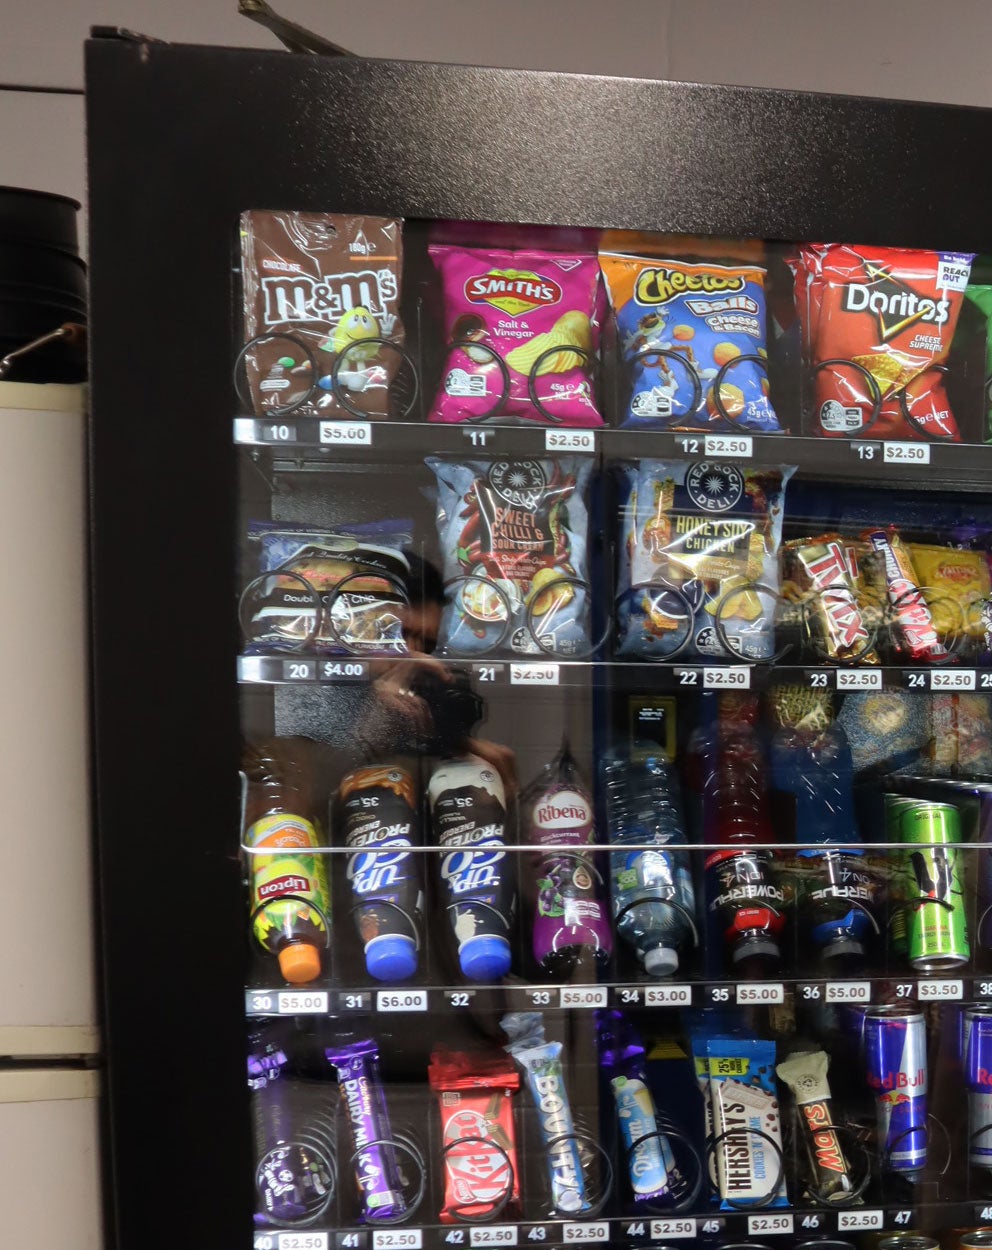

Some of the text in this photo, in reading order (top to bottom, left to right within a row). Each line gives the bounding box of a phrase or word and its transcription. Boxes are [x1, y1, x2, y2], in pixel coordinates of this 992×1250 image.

[635, 267, 745, 306] Cheetos
[687, 296, 759, 316] Balls
[846, 283, 951, 322] Doritos
[498, 320, 529, 330] Salt &
[493, 327, 535, 339] Vinegar
[915, 334, 942, 345] CHEESE
[271, 425, 366, 440] 10 $5.00
[470, 431, 590, 447] 11 $2.50
[682, 439, 699, 453] 12
[857, 446, 925, 460] 13 $2.50
[690, 464, 709, 488] RED
[696, 493, 731, 509] DELI
[494, 506, 537, 528] SWEET
[491, 522, 532, 540] CHILLI
[676, 515, 720, 535] HONEY
[289, 662, 363, 679] 20 $4.00
[479, 668, 496, 681] 21
[679, 671, 745, 685] 22 $2.50
[810, 674, 828, 687] 23
[908, 674, 926, 687] 24
[537, 805, 587, 824] Ribena
[259, 877, 306, 897] Lipton
[532, 991, 550, 1005] 33
[621, 989, 687, 1003] 34 $3.00
[711, 988, 729, 1002] 35
[803, 986, 866, 1000] 36 $5.00
[896, 984, 912, 998] 37
[253, 995, 322, 1009] 30 $5.00
[345, 995, 362, 1008] 31
[450, 993, 469, 1007] 32
[895, 1071, 925, 1088] Bull
[344, 1080, 365, 1126] DAIRY
[801, 1215, 819, 1229] 46
[894, 1210, 912, 1224] 47
[528, 1227, 546, 1240] 43
[626, 1222, 645, 1236] 44
[702, 1220, 720, 1233] 45
[254, 1236, 322, 1250] 40 $2.50
[342, 1233, 359, 1247] 41
[445, 1230, 513, 1244] 42 $2.50
